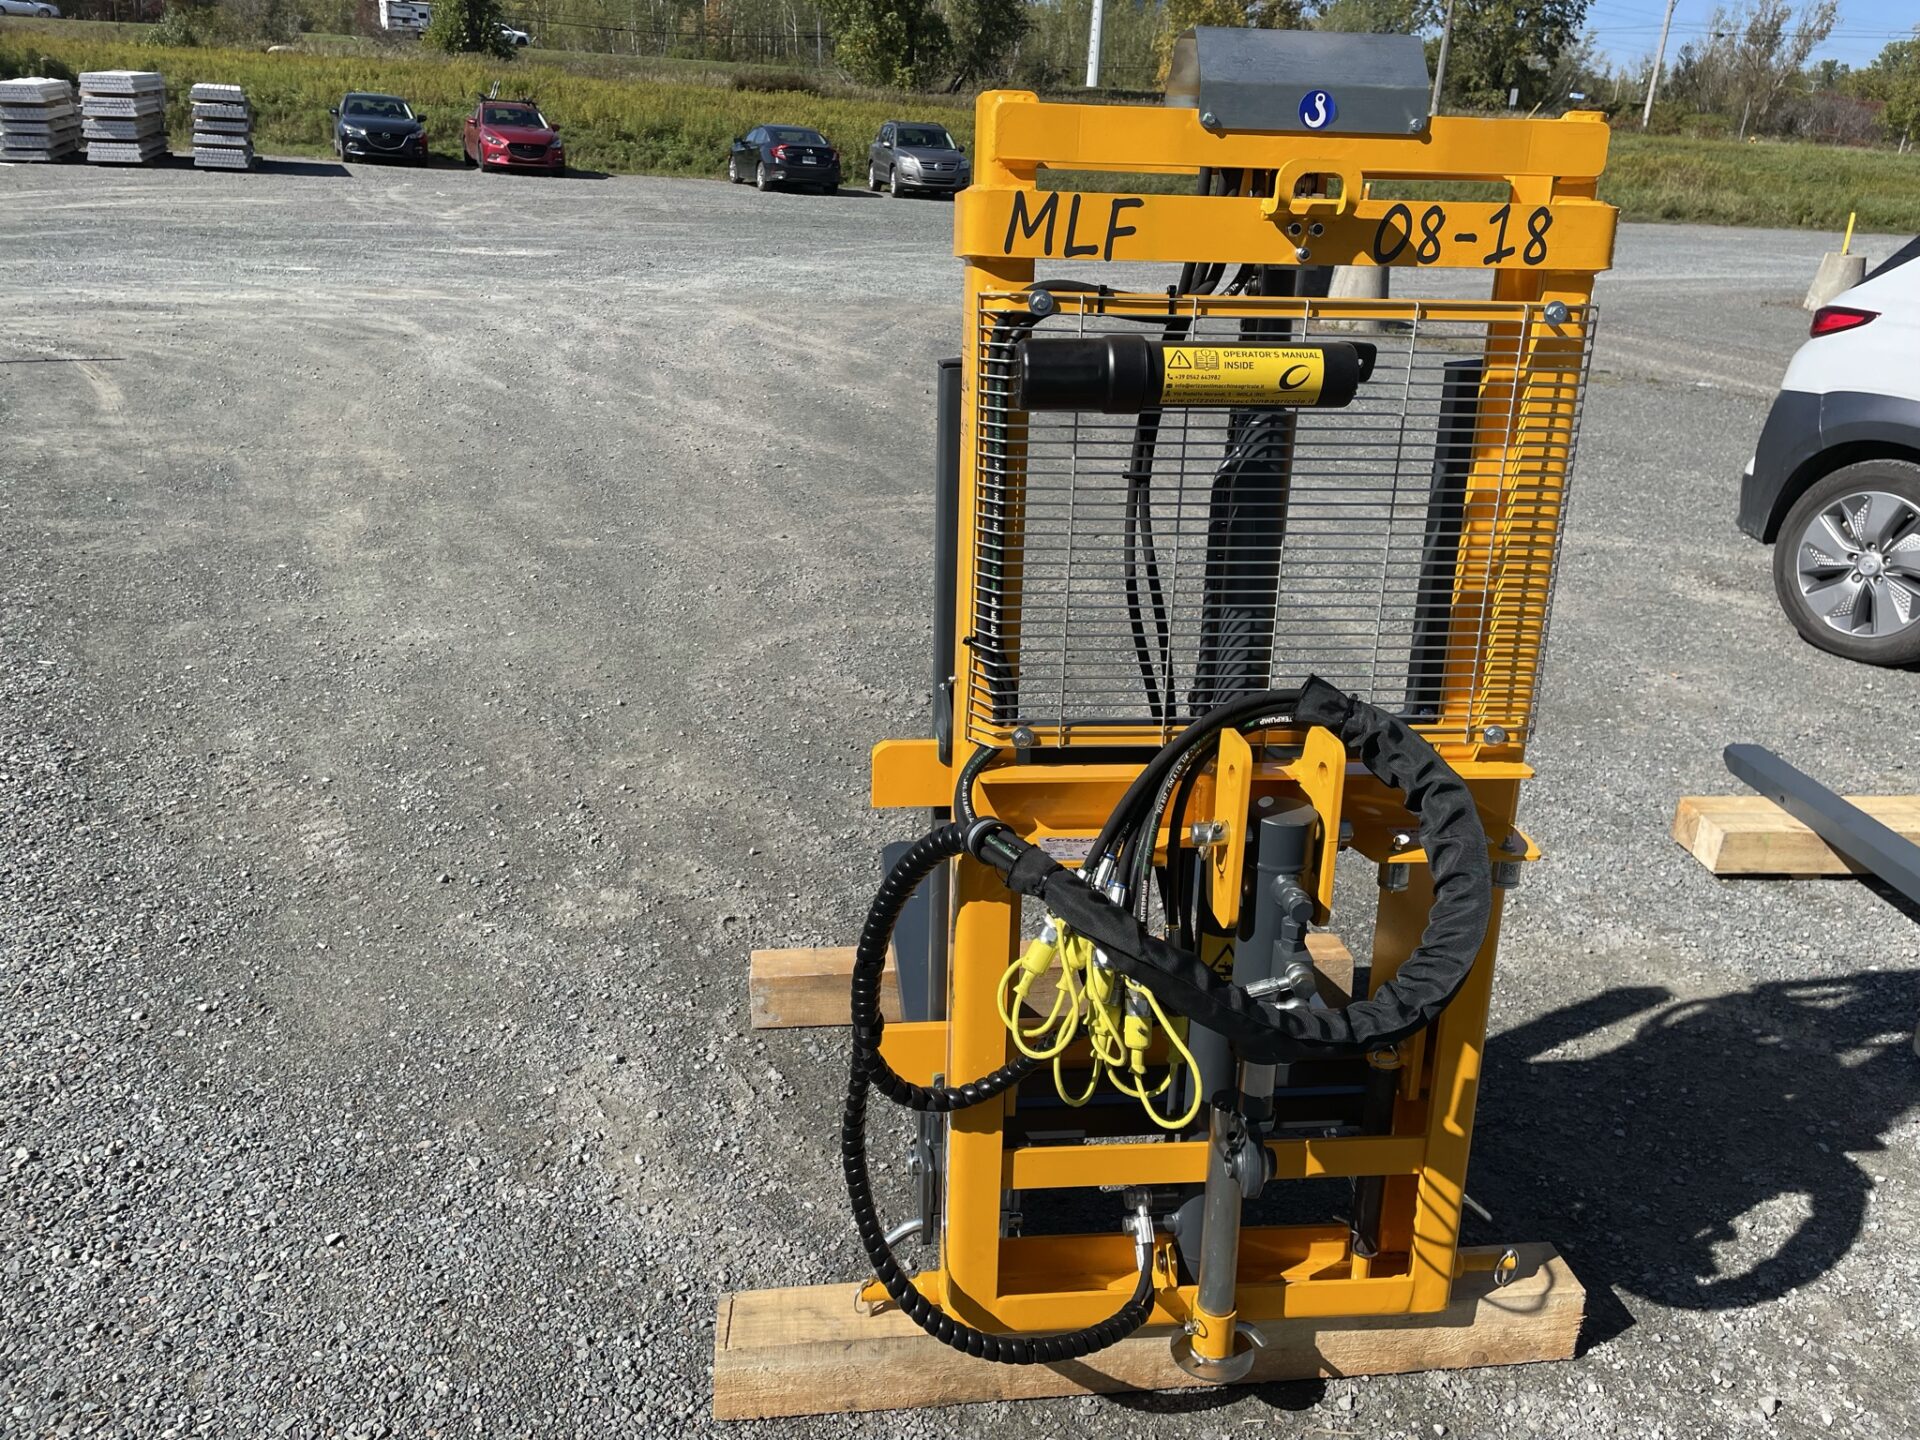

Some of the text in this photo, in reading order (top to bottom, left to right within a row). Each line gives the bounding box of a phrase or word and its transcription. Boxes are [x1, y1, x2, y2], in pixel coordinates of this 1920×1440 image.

[1003, 190, 1553, 266] MLF 08-18
[1223, 350, 1321, 360] OPERATOR'S MANUAL
[1223, 361, 1255, 370] INSIDE
[1140, 880, 1149, 923] INTERPUMP
